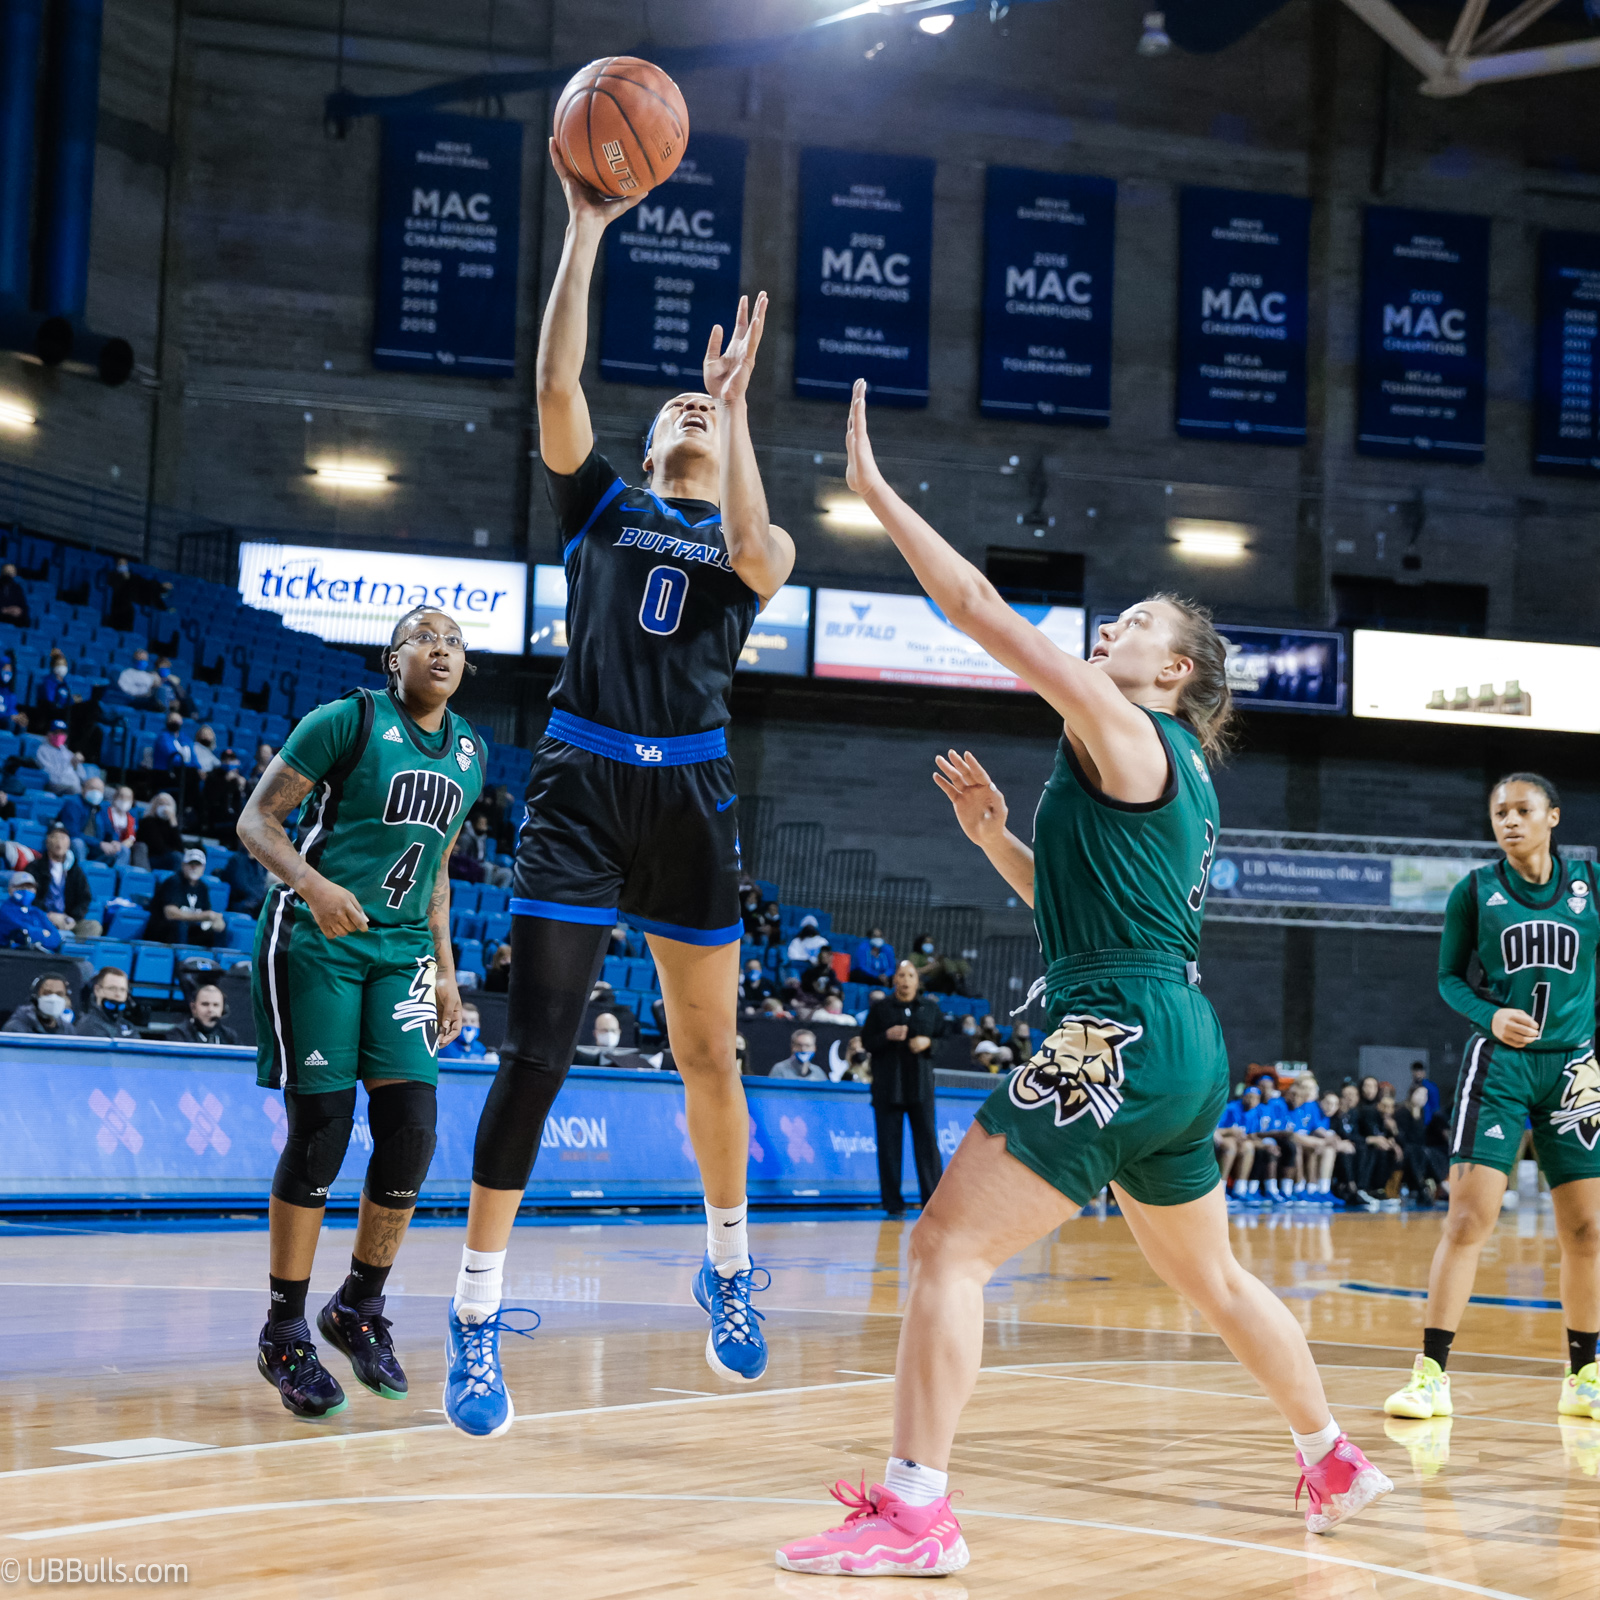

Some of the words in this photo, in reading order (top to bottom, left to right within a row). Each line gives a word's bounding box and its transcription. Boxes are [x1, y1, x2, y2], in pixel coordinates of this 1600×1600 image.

[602, 140, 638, 191] ELITE
[412, 187, 491, 221] MAC
[404, 217, 438, 231] EAST
[440, 220, 498, 236] DIVISION
[637, 205, 715, 238] MAC
[403, 231, 498, 253] CHAMPIONS
[680, 238, 732, 255] SEASON
[629, 247, 721, 270] CHAMPIONS
[821, 247, 911, 286] MAC
[820, 281, 910, 302] CHAMPIONS
[1005, 265, 1093, 304] MAC
[1005, 300, 1093, 321] CHAMPIONS
[1202, 286, 1287, 324] MAC
[1201, 320, 1288, 340] CHAMPIONS
[1382, 303, 1466, 341] MAC
[845, 327, 885, 341] NCAA
[817, 338, 909, 360] TOURNAMENT
[1027, 345, 1067, 359] NCAA
[1382, 335, 1466, 357] CHAMPIONS
[1002, 357, 1093, 378] TOURNAMENT
[1199, 364, 1287, 383] TOURNAMENT
[259, 564, 508, 613] ticketmaster
[638, 565, 690, 636] 0
[825, 621, 897, 641] BUFFALO
[382, 770, 463, 838] OHIO
[381, 842, 425, 909] 4
[1243, 860, 1267, 876] UB
[1267, 861, 1336, 880] Welcomes
[1336, 864, 1361, 880] the
[1500, 920, 1579, 975] OHIO
[1531, 982, 1550, 1040] 1
